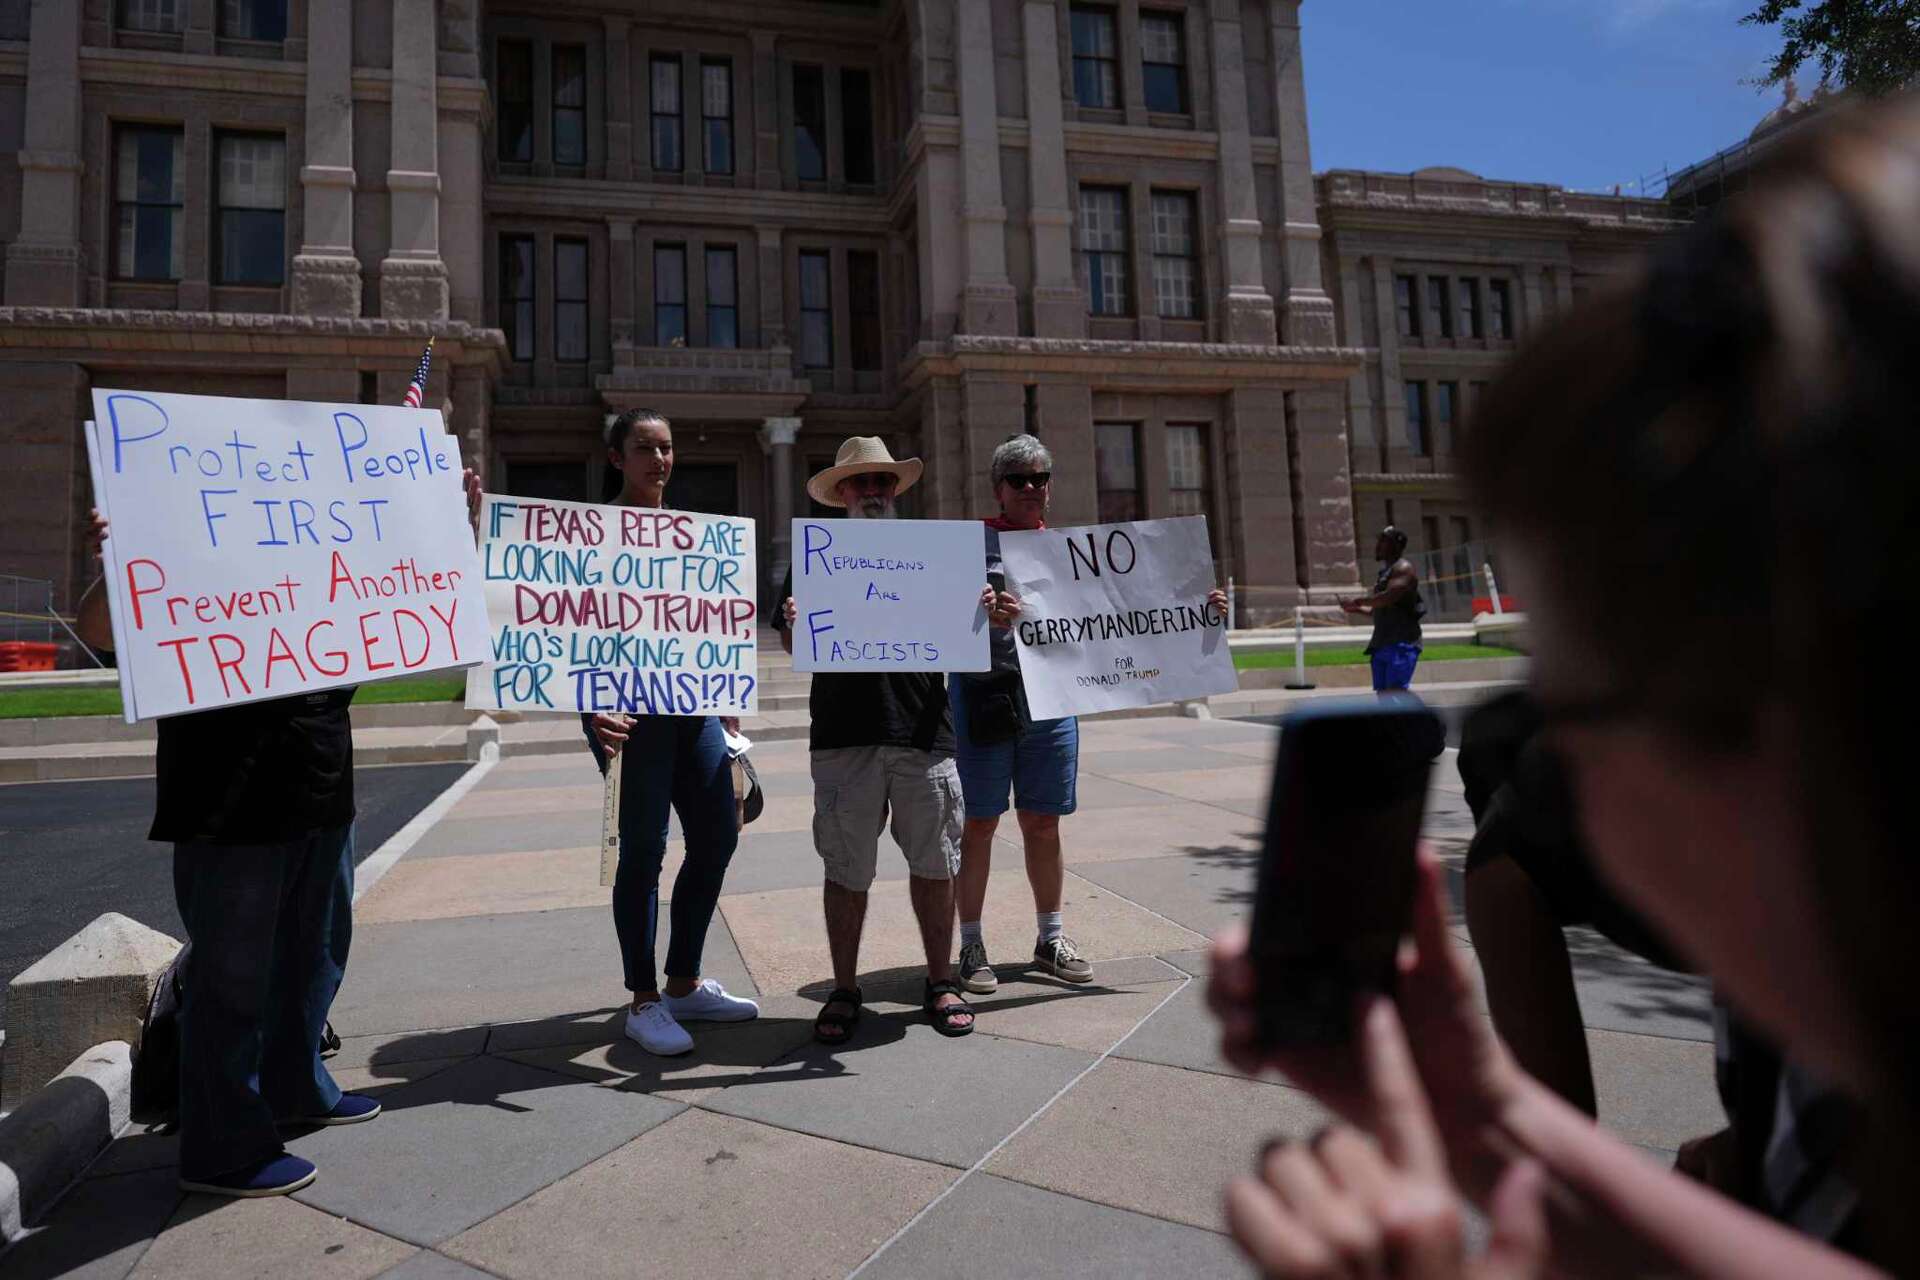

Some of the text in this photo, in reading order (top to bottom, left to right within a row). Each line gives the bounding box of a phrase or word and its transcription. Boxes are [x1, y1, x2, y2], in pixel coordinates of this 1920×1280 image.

[107, 394, 450, 483] Protect People
[200, 489, 389, 547] FIRST
[490, 502, 746, 556] IF TEXAS REPS ARE
[485, 544, 742, 595] LOOKING OUT FOR
[1066, 530, 1136, 581] NO
[126, 550, 462, 630] Prevent Another
[515, 583, 643, 632] DONALD
[1019, 601, 1221, 647] GERRYMANDERING
[157, 599, 458, 704] TRAGEDY
[570, 632, 685, 668] LOOKING
[695, 641, 754, 670] OUT
[1115, 656, 1134, 670] FOR
[493, 662, 755, 715] FOR TEXANS!?!?
[1076, 668, 1160, 687] DONALD TRUMP
